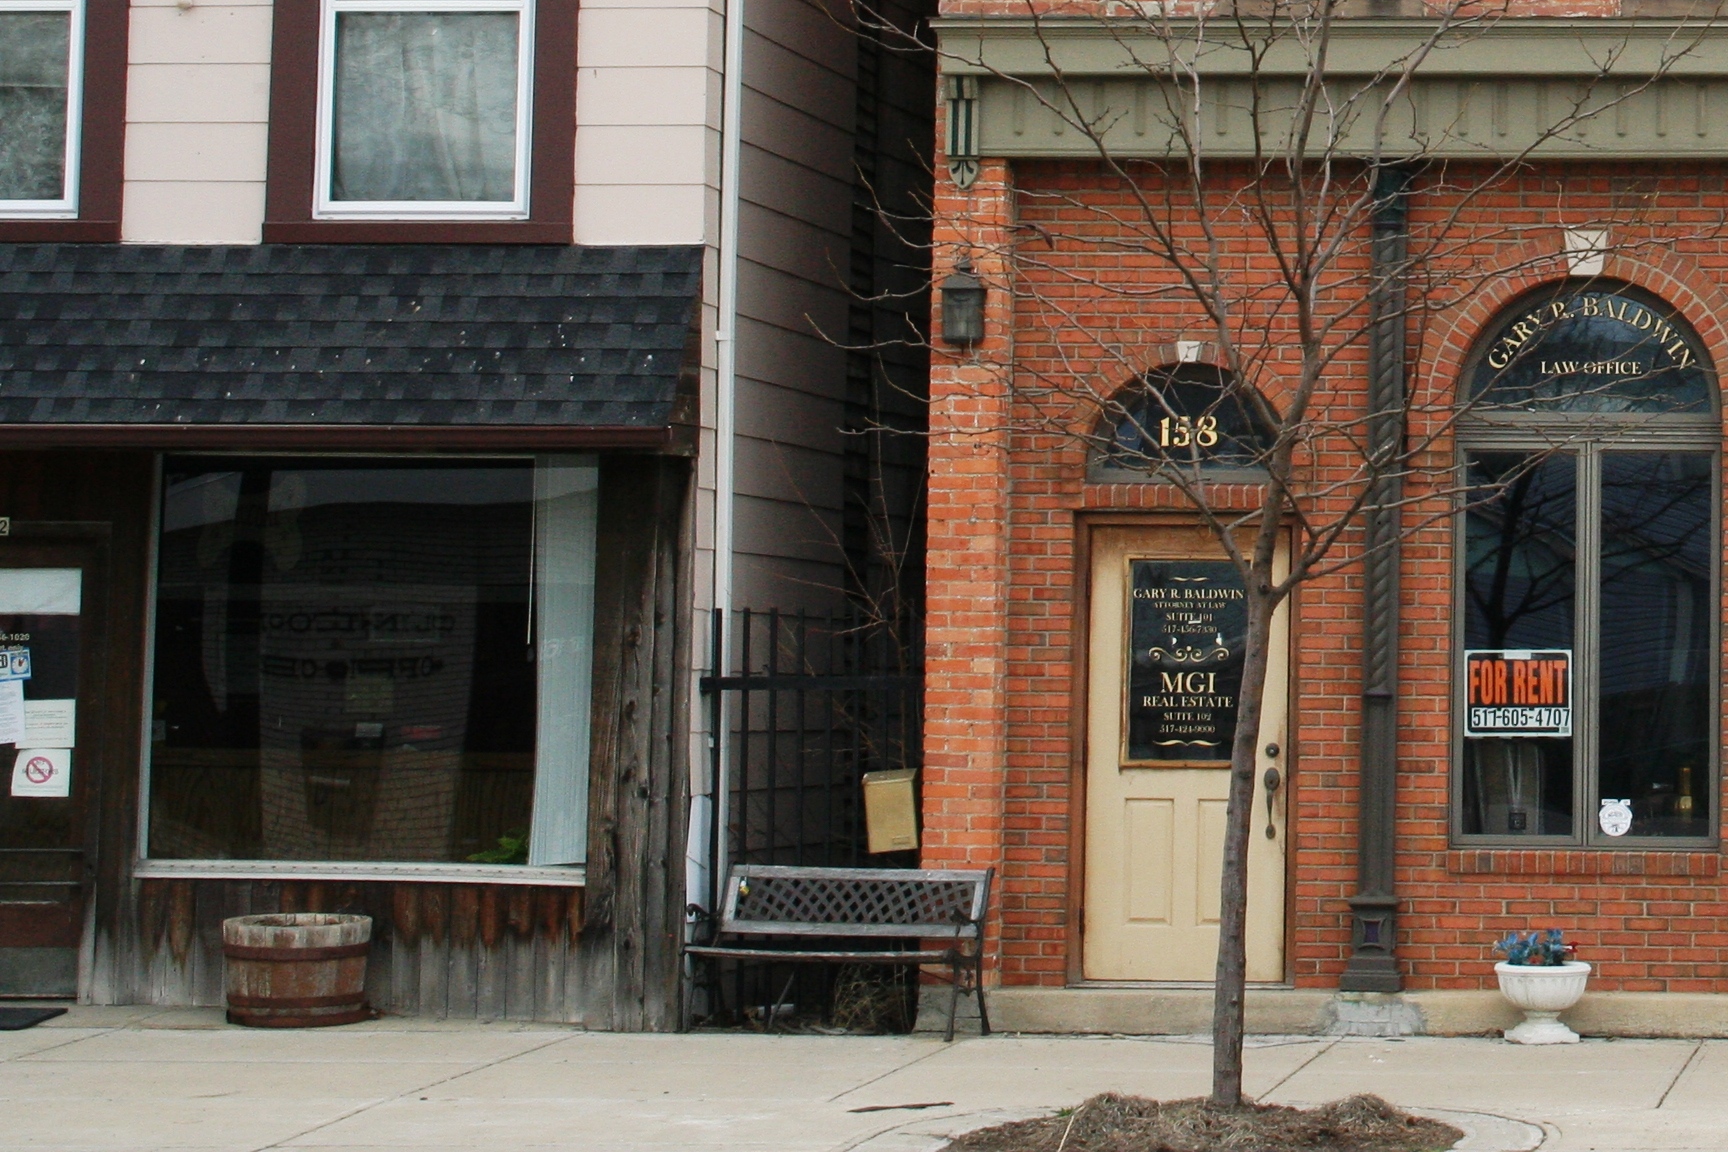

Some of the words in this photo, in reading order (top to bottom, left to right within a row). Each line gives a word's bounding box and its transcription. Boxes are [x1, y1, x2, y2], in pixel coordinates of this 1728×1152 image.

[1488, 308, 1544, 370] GARY
[1551, 300, 1575, 320] R.
[1582, 297, 1697, 371] BALDWIN
[1540, 361, 1579, 375] LAW
[1583, 361, 1642, 375] OFFICE
[1160, 415, 1218, 447] 158
[1133, 588, 1168, 600] GARY
[1184, 588, 1244, 600] BALDWIN
[1154, 601, 1195, 609] ATTORNEY
[1197, 601, 1208, 609] AT
[1208, 601, 1226, 609] LAW
[1166, 612, 1196, 622] SUITE
[1160, 671, 1216, 694] MGI
[1469, 660, 1507, 704] FOR
[1513, 660, 1567, 704] RENT
[1143, 695, 1179, 707] REAL
[1181, 695, 1234, 708] ESTATE
[1163, 712, 1195, 722] SUITE
[1196, 712, 1212, 722] 102
[1472, 708, 1570, 727] 517-605-4707
